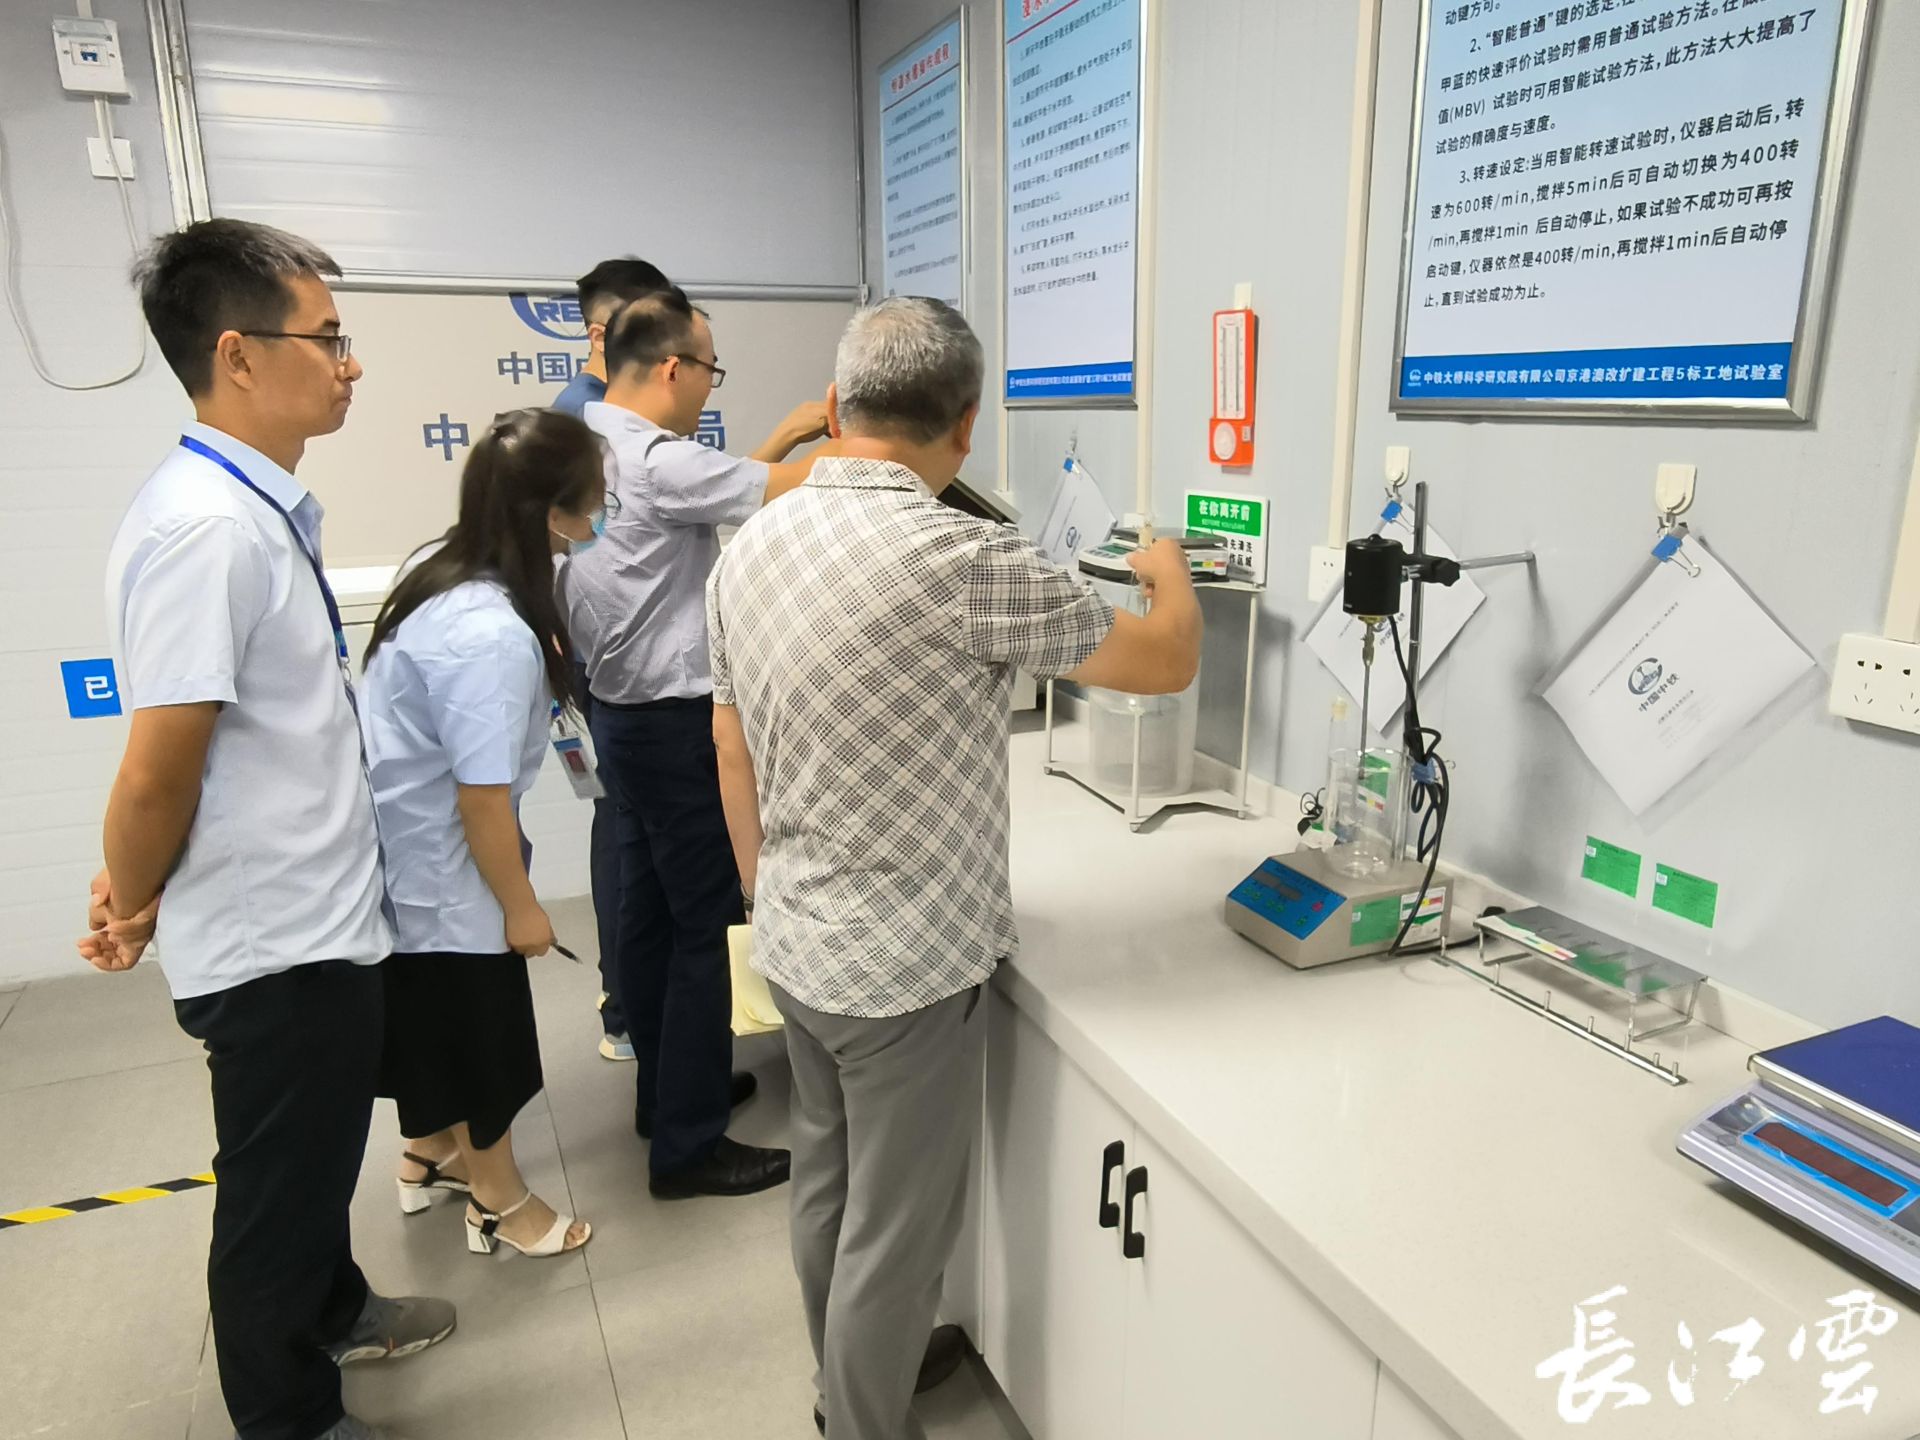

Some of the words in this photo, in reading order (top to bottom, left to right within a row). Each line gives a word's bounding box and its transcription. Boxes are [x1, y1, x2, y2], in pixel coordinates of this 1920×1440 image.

[1435, 115, 1556, 155] 试验的精确度与速度。
[1198, 499, 1250, 522] 在你离开前
[1638, 672, 1680, 712] 中国中铁
